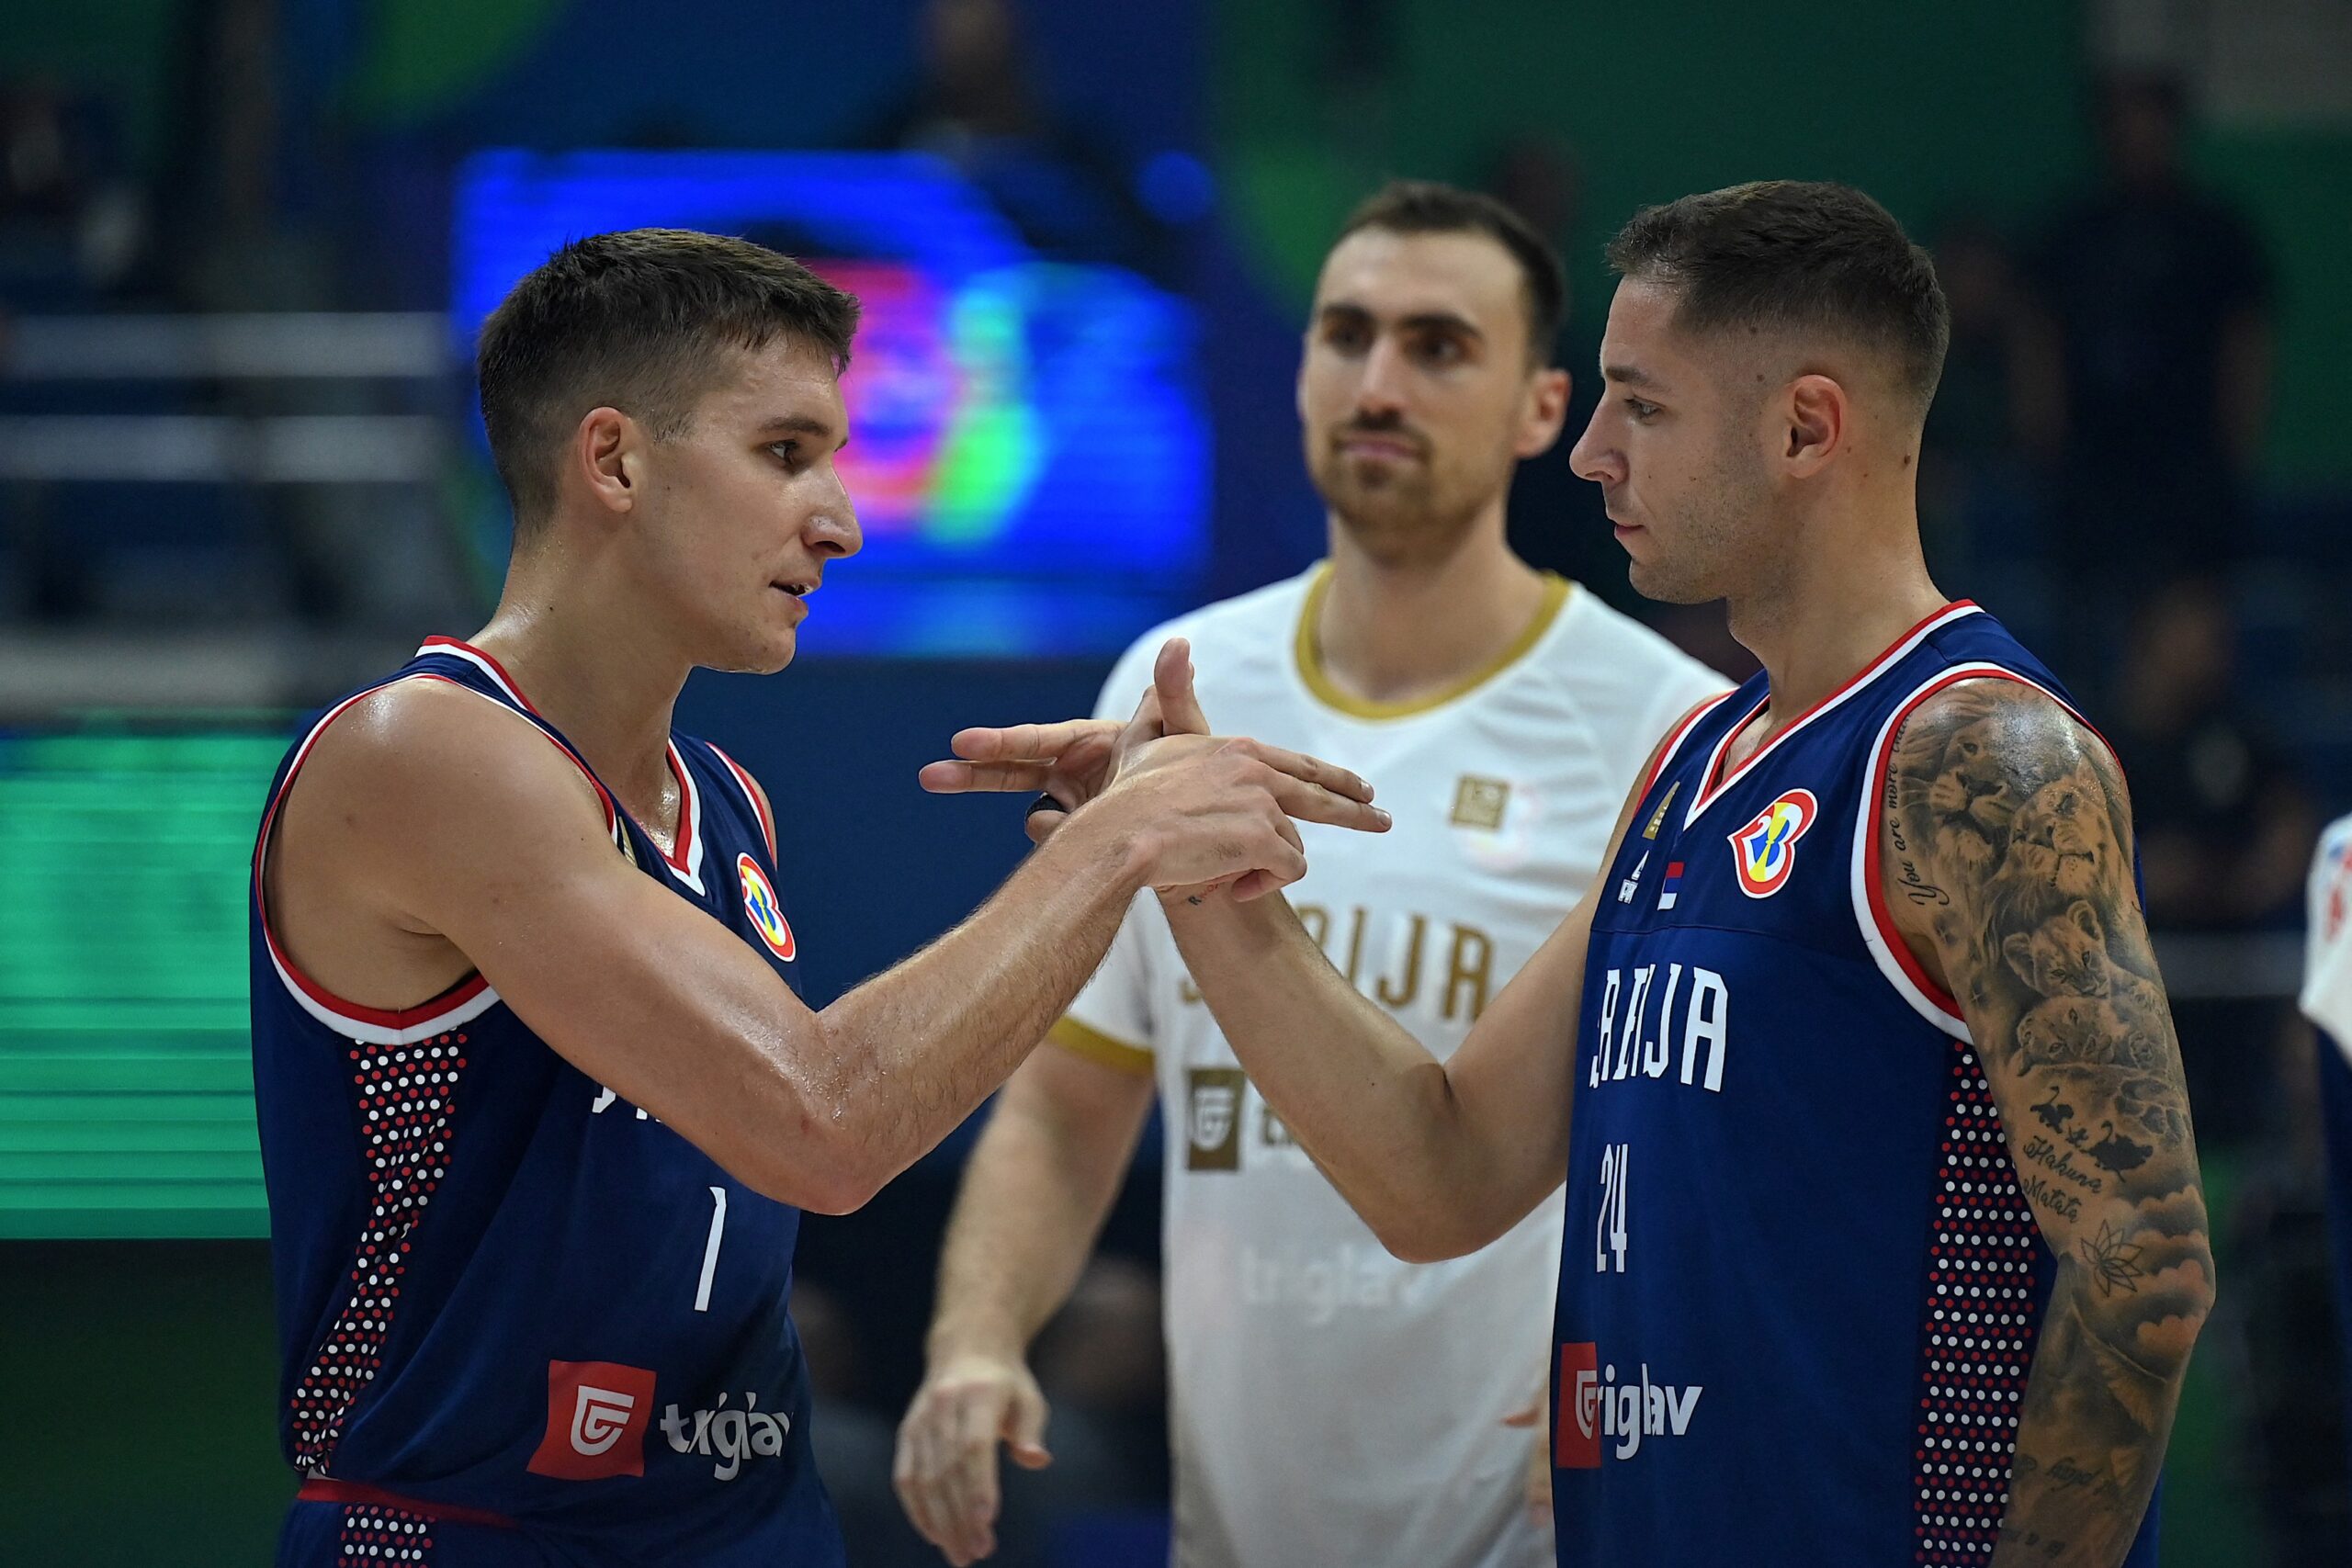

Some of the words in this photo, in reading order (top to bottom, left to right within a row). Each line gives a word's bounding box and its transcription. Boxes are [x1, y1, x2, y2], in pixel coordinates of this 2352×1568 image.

[1887, 762, 1898, 809] more
[1889, 819, 1906, 852] are
[1898, 861, 1950, 905] You
[2023, 1135, 2103, 1194] Hakuna
[1595, 1142, 1629, 1275] 24
[2023, 1175, 2083, 1224] Matata
[694, 1186, 727, 1312] 1
